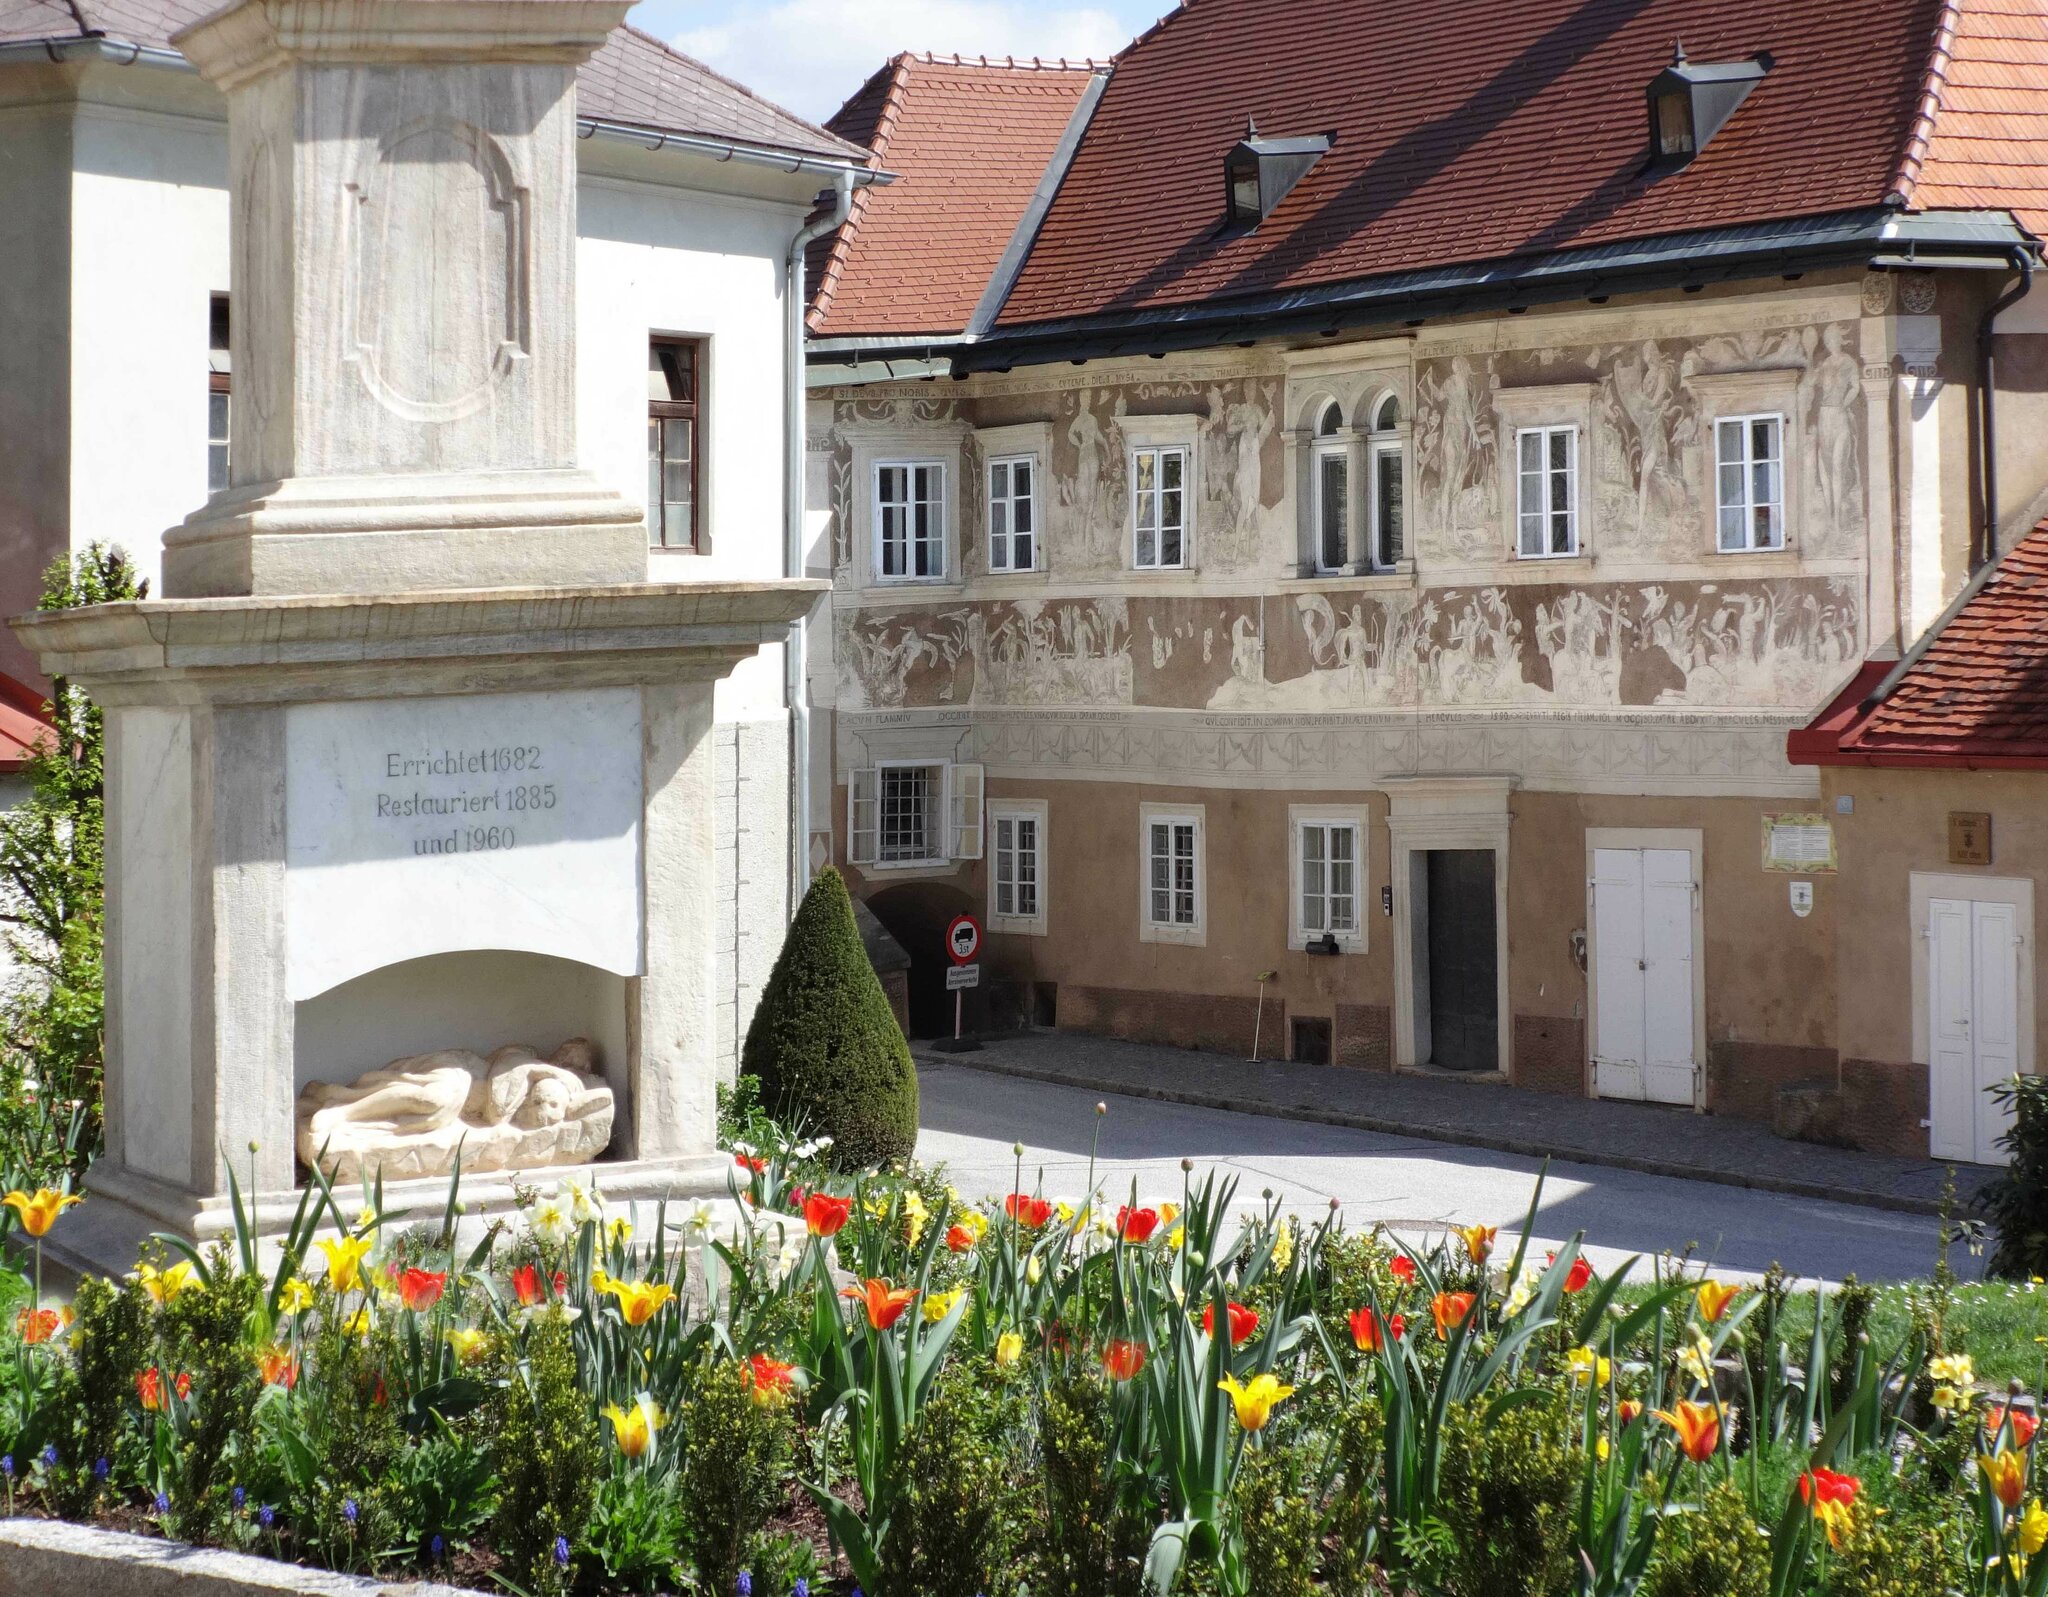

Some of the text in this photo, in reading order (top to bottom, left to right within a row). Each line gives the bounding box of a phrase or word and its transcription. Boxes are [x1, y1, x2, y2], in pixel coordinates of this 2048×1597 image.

[386, 750, 487, 777] Errichtet
[377, 785, 556, 817] Restauriert 1885
[414, 826, 515, 855] und 1960
